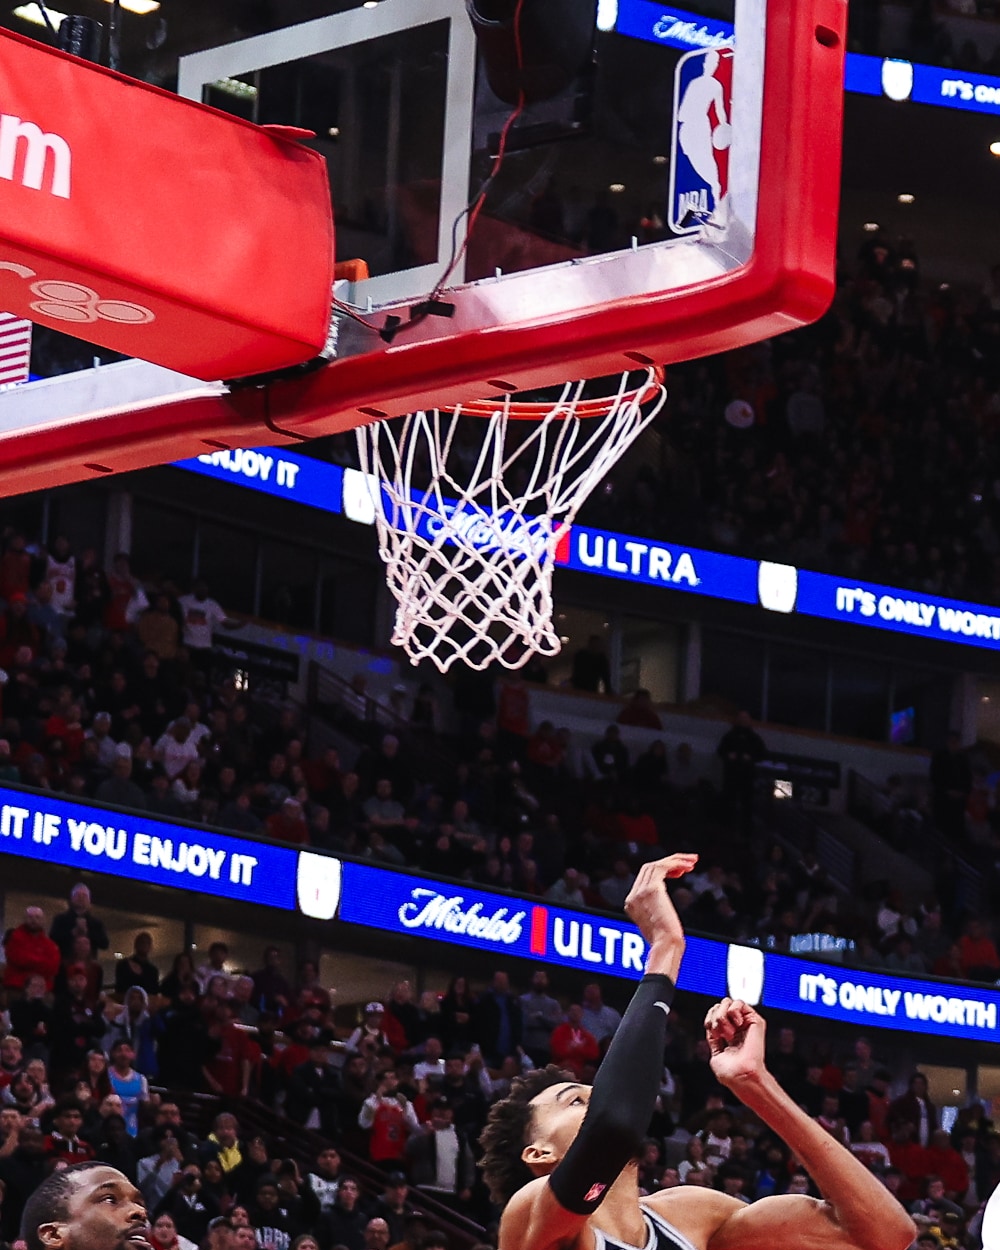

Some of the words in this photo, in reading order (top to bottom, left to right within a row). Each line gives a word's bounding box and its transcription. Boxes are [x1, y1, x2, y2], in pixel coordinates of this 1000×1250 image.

[653, 15, 735, 49] Michelo
[941, 79, 974, 100] IT'S
[276, 460, 299, 489] IT
[578, 533, 701, 586] ULTRA
[836, 586, 876, 617] IT'S
[878, 595, 936, 627] ONLY
[0, 805, 29, 839] IT
[33, 811, 61, 845] IF
[66, 818, 127, 861] YOU
[132, 832, 226, 880] ENJOY
[229, 853, 258, 886] IT
[398, 887, 526, 944] Michelob
[553, 917, 646, 971] ULTR
[799, 973, 838, 1006] IT'S
[839, 981, 901, 1016] ONLY
[903, 991, 997, 1029] WORTH
